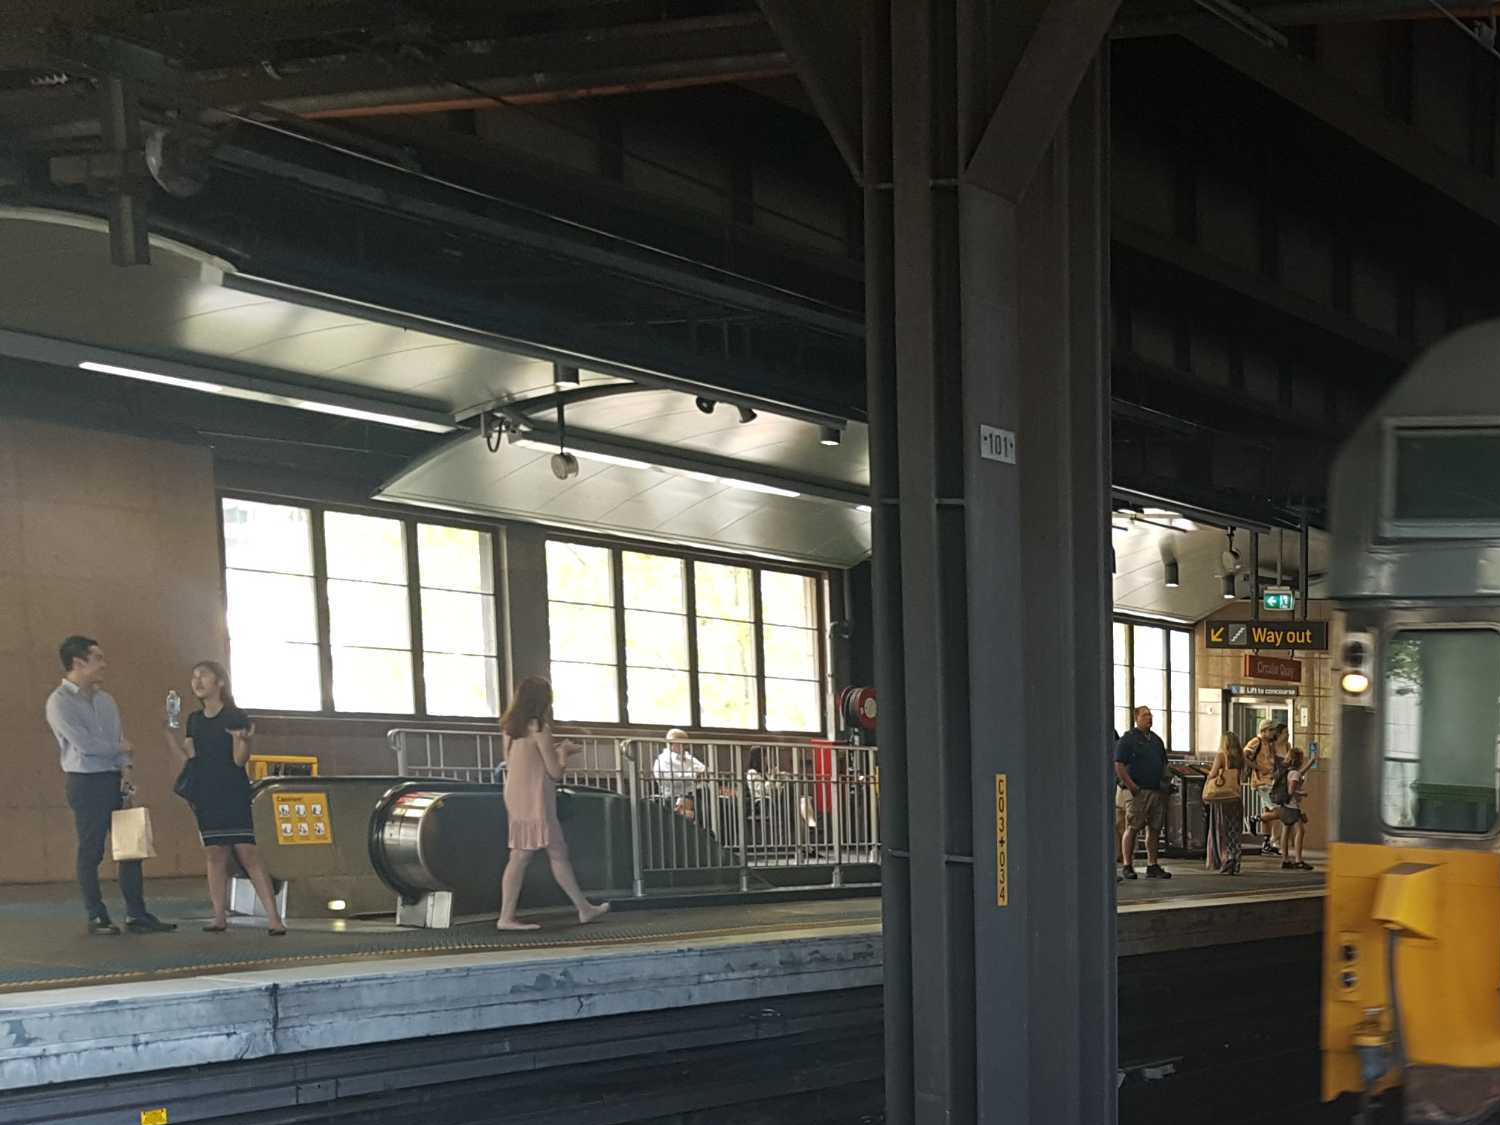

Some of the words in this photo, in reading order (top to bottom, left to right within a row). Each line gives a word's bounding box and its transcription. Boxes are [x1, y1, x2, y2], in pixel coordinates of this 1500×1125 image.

[989, 432, 1009, 457] 101
[1251, 627, 1284, 646] Way
[1286, 629, 1312, 644] out
[1246, 687, 1258, 695] Lift
[1258, 687, 1265, 695] to
